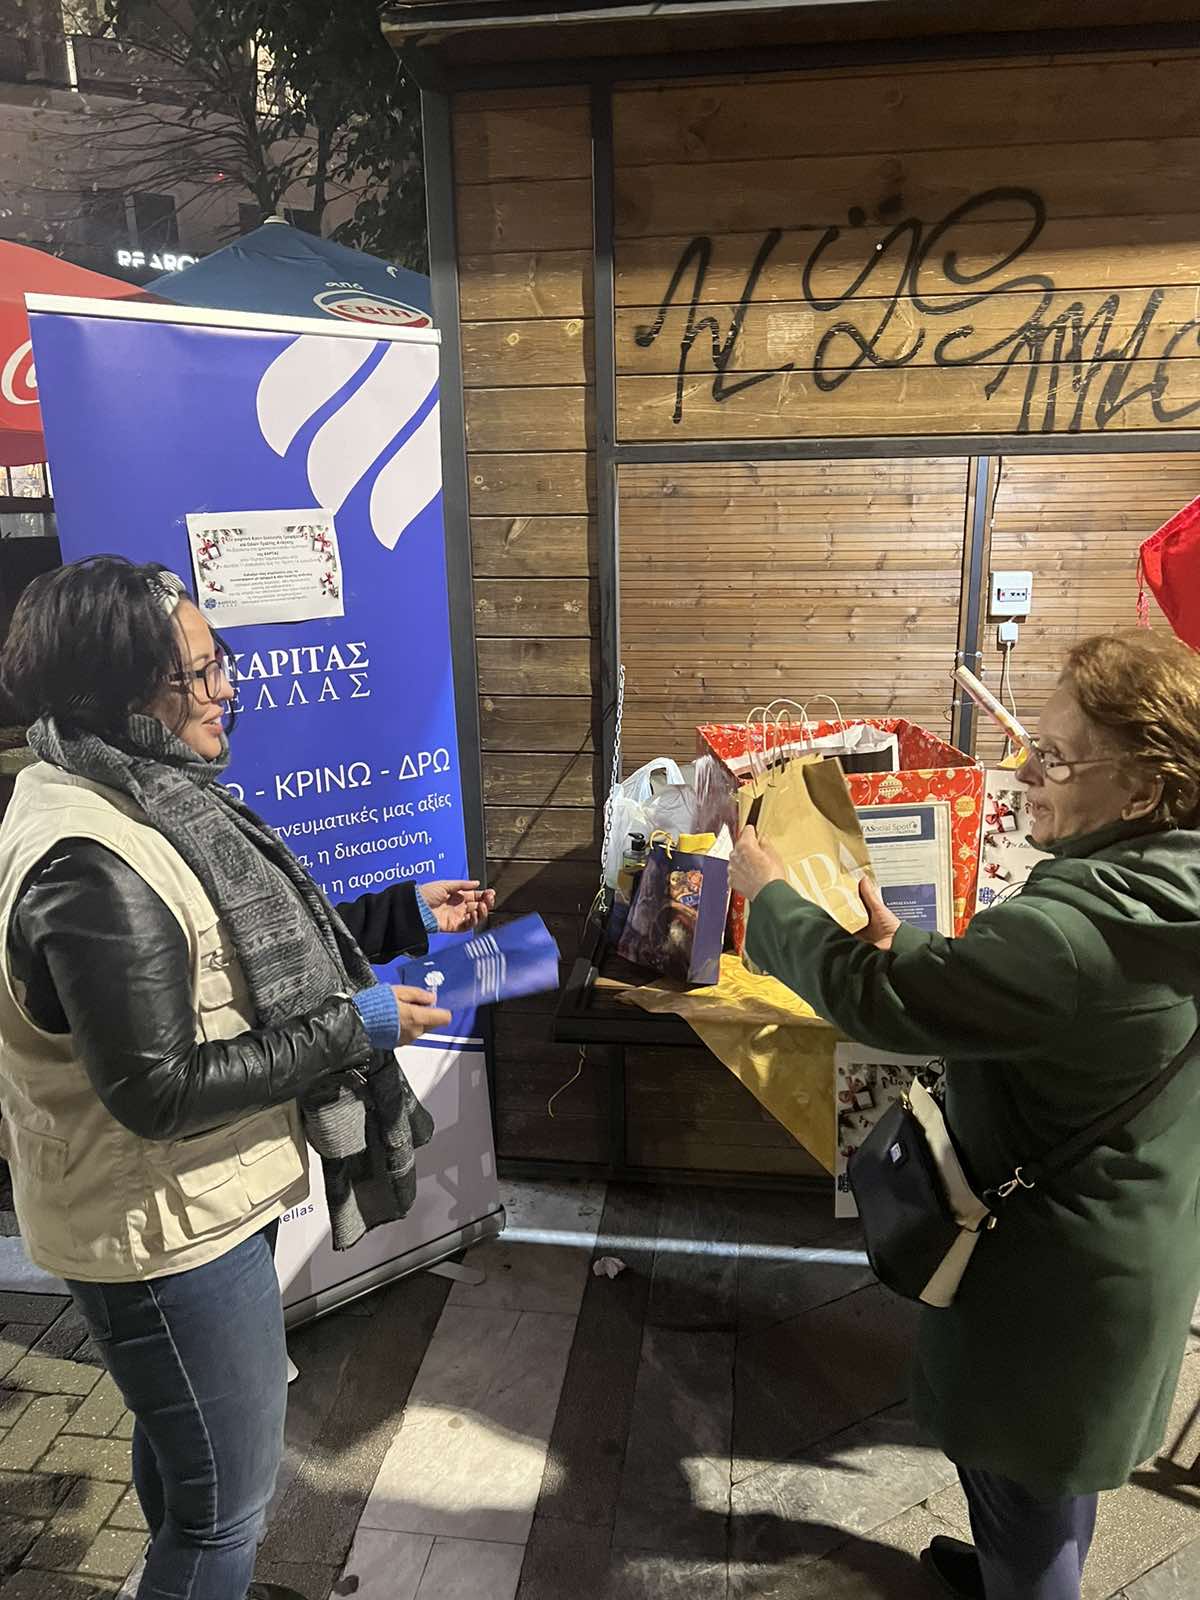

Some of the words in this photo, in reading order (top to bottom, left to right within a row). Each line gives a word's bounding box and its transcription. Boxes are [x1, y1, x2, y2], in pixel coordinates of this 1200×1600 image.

[223, 641, 369, 682] ΚΑΡΙΤΑΣ
[275, 761, 371, 801] ΚΡΙΝΩ
[399, 748, 451, 781] ΔΡΩ
[383, 802, 415, 822] μας
[417, 793, 452, 813] αξίες
[317, 850, 330, 865] η
[334, 830, 433, 860] δικαιοσύνη,
[332, 879, 344, 895] η
[348, 859, 436, 889] αφοσίωση
